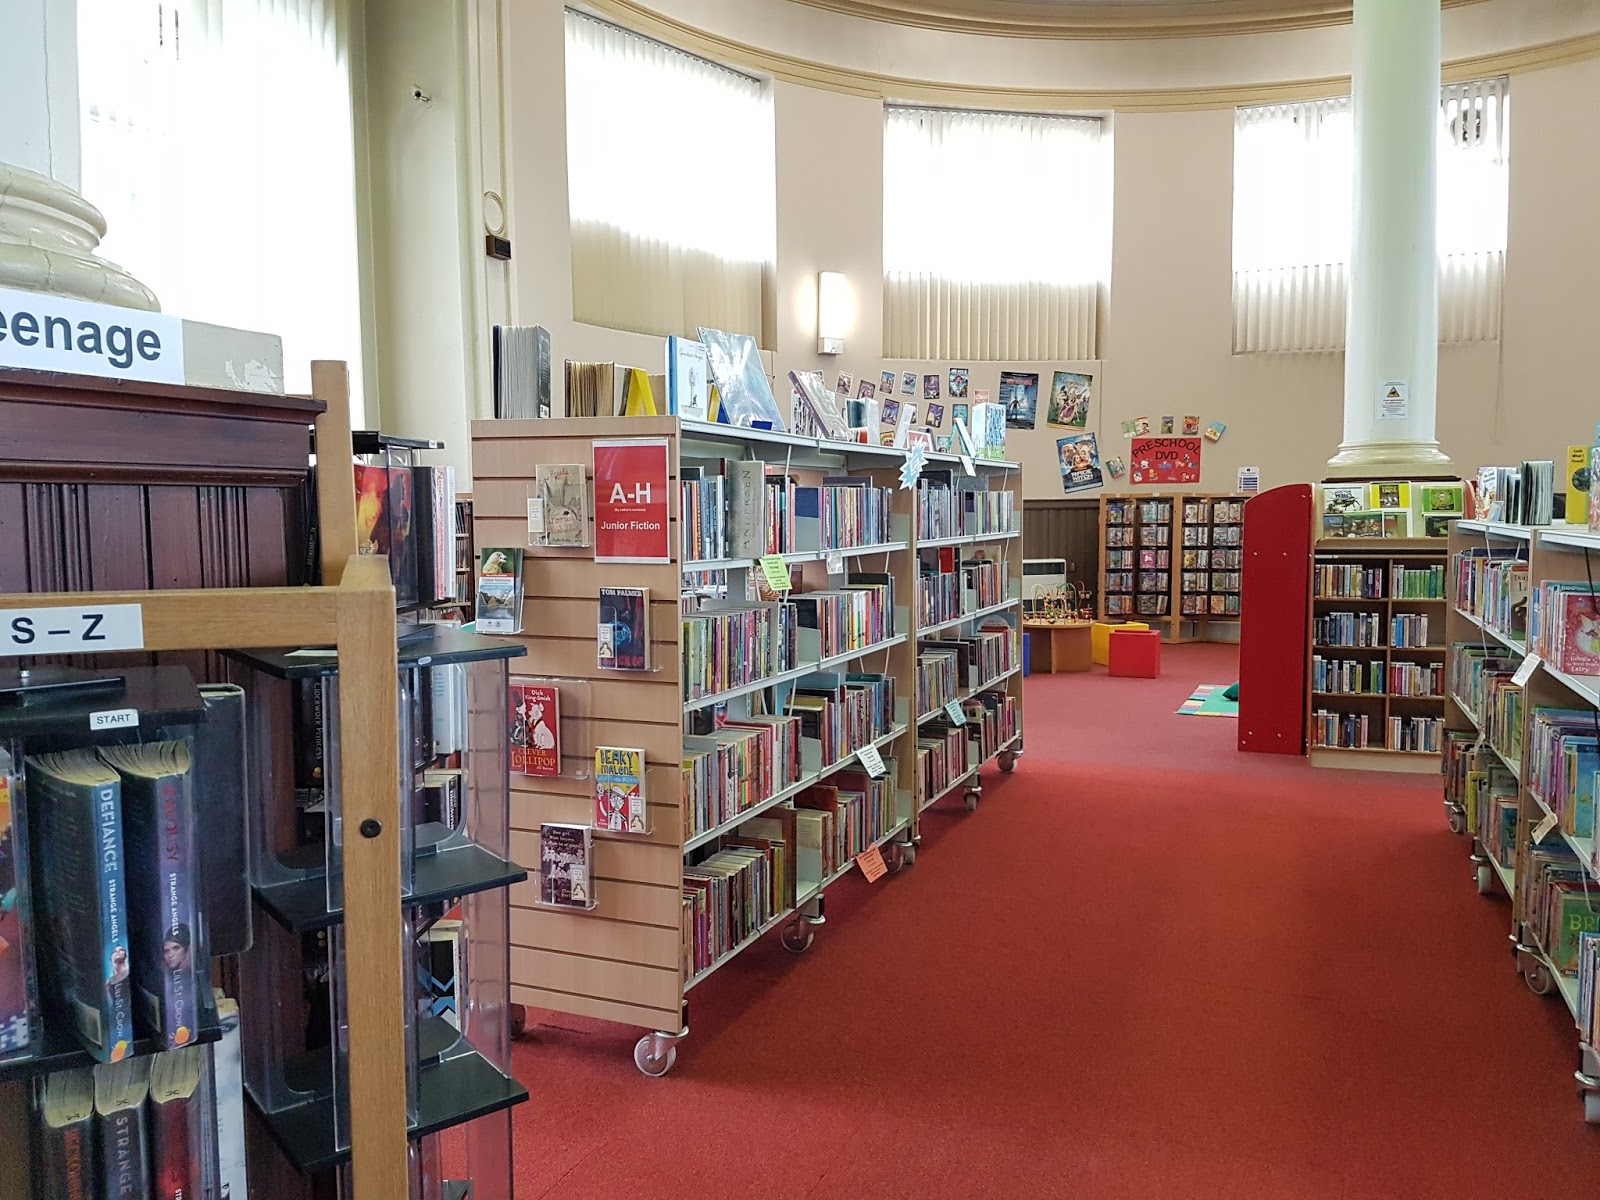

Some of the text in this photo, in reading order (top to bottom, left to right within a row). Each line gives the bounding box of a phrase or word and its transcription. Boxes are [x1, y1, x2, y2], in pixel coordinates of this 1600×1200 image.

[0, 310, 162, 369] enage
[1132, 438, 1200, 458] PRESCHOOL
[1155, 450, 1179, 460] DVD
[609, 482, 651, 504] A-H
[600, 521, 660, 530] Junior Fiction
[600, 588, 643, 597] TOM PALMER
[525, 694, 551, 703] King-Smith
[96, 713, 131, 725] START
[314, 682, 324, 760] Clockwork Princess
[511, 751, 556, 768] LOLLIPOP
[601, 764, 634, 776] MALONE
[100, 788, 117, 873] DEFIANCE
[108, 879, 119, 943] STRANGE ANGELS
[169, 873, 179, 936] STRANGE ANGELS
[174, 1000, 184, 1027] CROW
[116, 1117, 132, 1195] STRANGE
